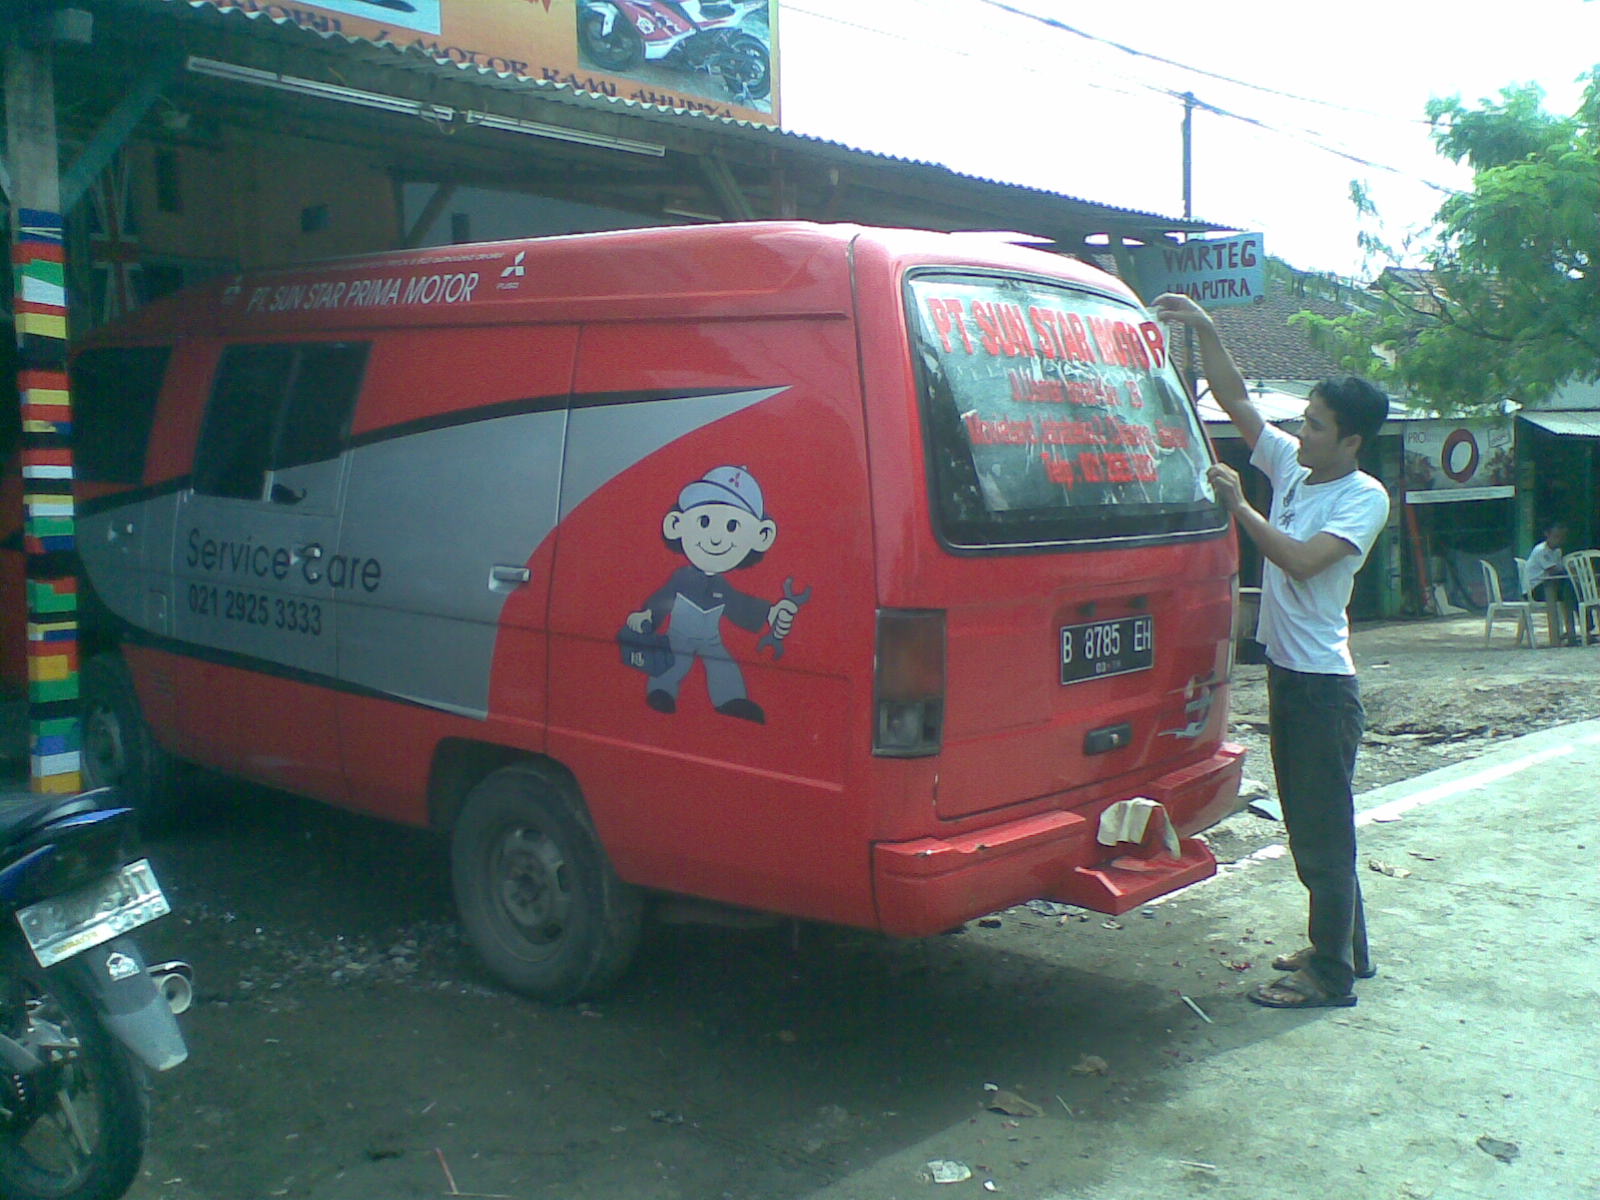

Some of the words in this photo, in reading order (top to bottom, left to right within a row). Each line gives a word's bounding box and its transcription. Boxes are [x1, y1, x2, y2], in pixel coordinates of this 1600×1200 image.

[1163, 240, 1257, 273] WARTEG
[270, 285, 306, 313] SUN
[304, 281, 346, 310] STAR
[344, 278, 402, 308] PRIMA
[402, 272, 480, 305] MOTOR
[928, 298, 974, 354] PT
[971, 300, 1036, 358] SUN
[1029, 305, 1096, 363] STAR
[187, 527, 290, 580] Service
[301, 542, 382, 593] Care
[188, 582, 219, 616] 021
[225, 589, 269, 626] 2925
[275, 598, 322, 636] 3333
[1063, 630, 1073, 664] B
[1084, 623, 1121, 660] 8785
[1133, 619, 1152, 652] EH
